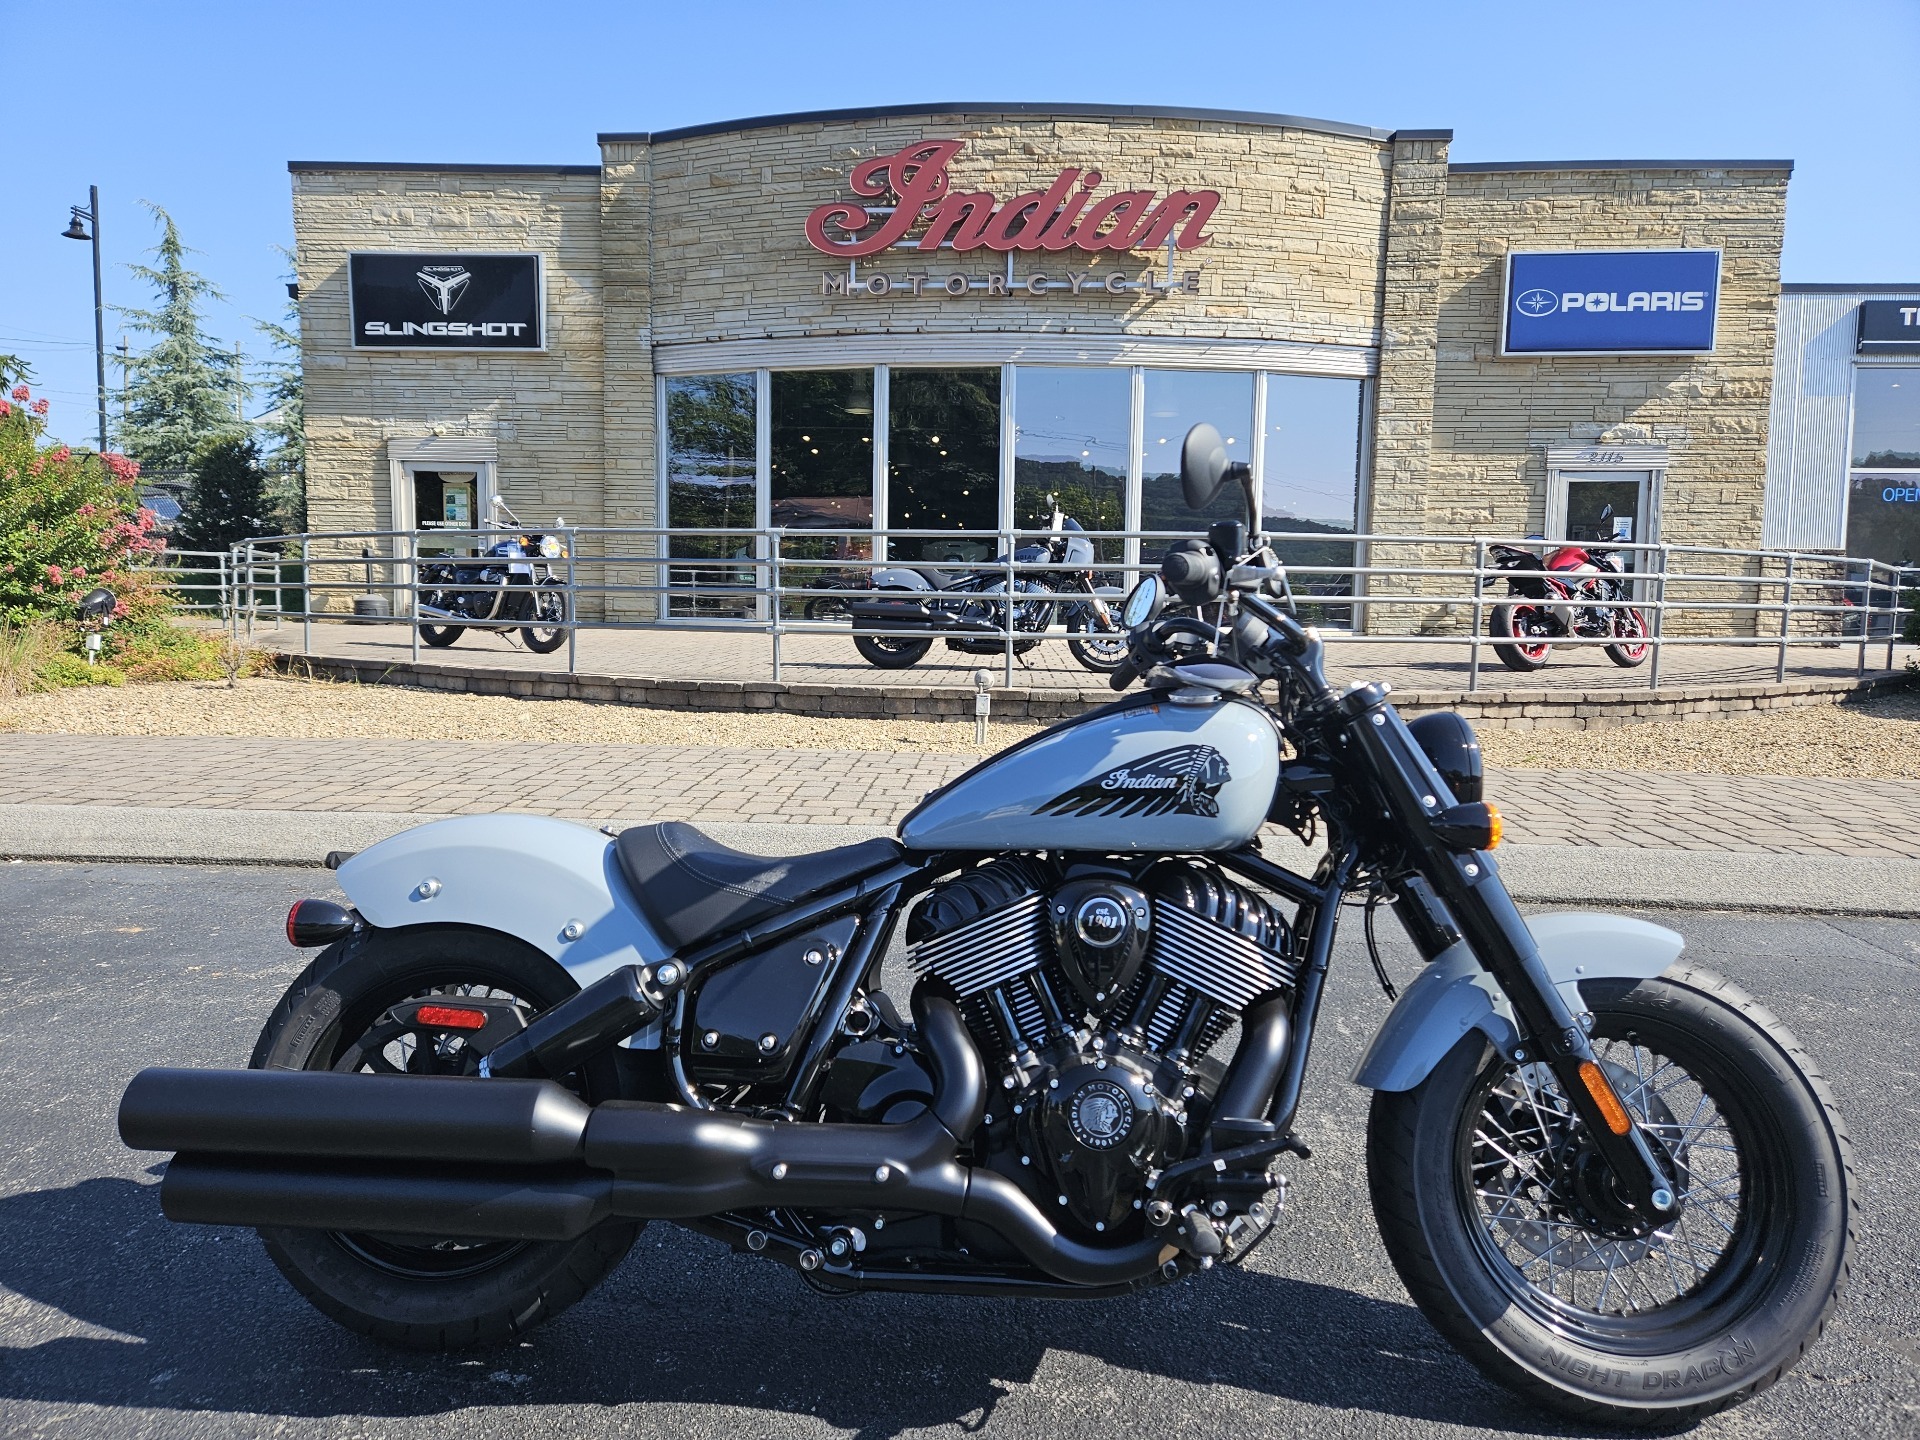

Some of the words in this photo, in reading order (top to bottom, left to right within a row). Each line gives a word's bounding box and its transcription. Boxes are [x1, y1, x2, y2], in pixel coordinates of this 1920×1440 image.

[804, 138, 1221, 258] Indian
[822, 270, 1201, 296] MOTORCYCLE
[1561, 291, 1704, 313] POLARIS
[364, 321, 527, 337] SLINGSHOT
[1100, 769, 1179, 790] Indian
[1088, 914, 1118, 929] 1901
[1087, 1083, 1132, 1136] MOTORCYCLE
[1089, 1137, 1113, 1147] 1901
[1541, 1345, 1631, 1388] NIGHT
[1642, 1337, 1757, 1390] DRAGON
